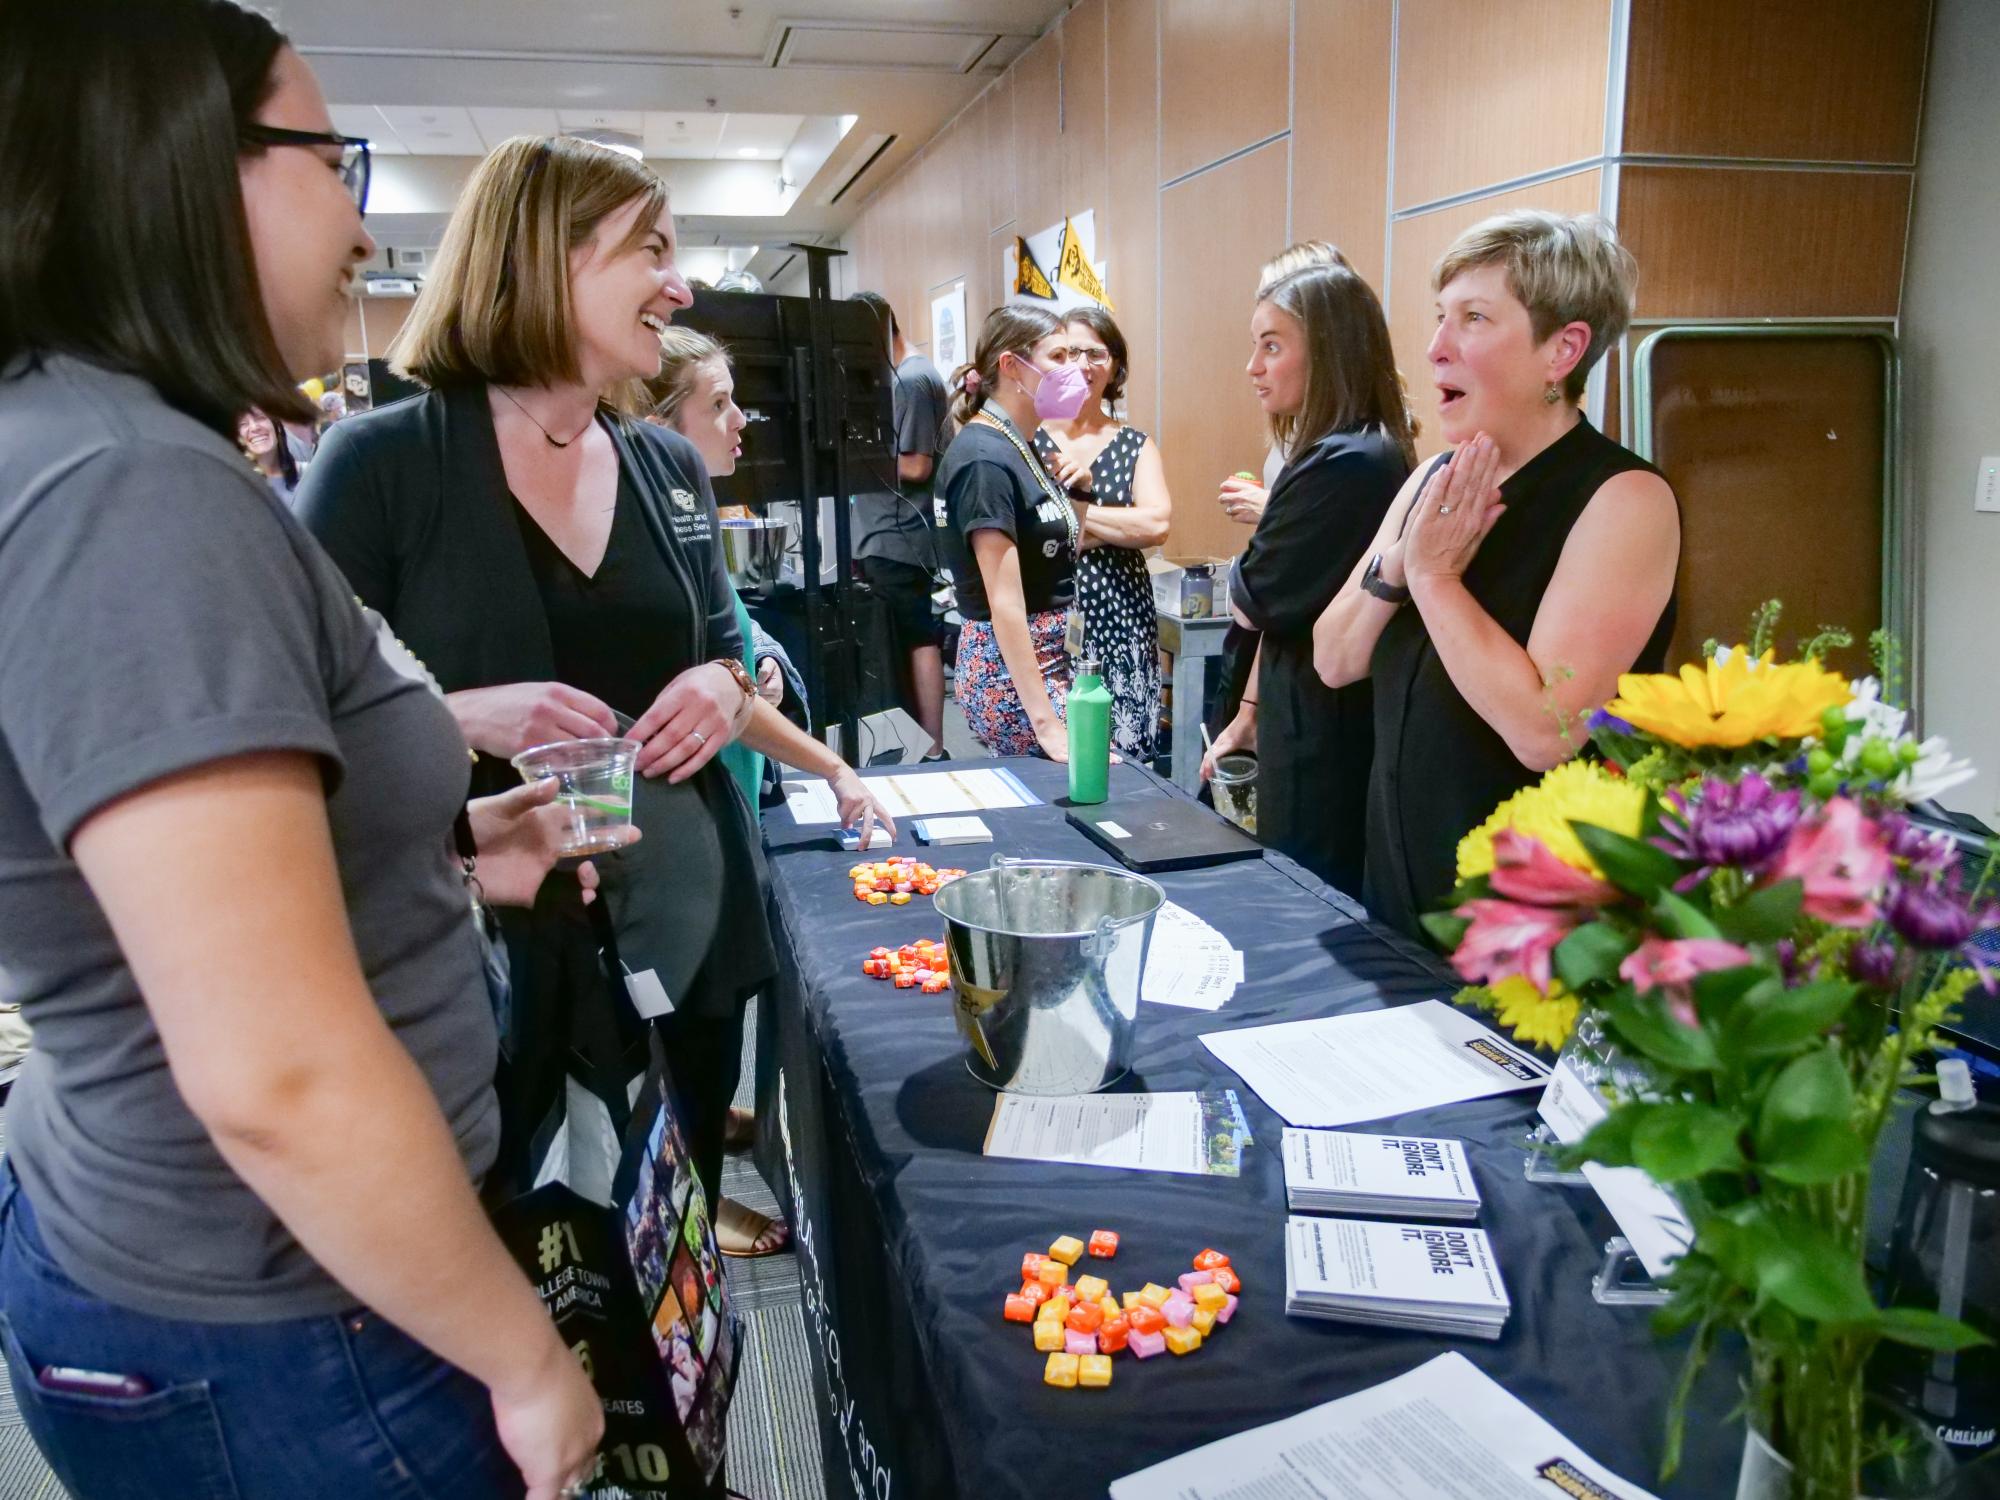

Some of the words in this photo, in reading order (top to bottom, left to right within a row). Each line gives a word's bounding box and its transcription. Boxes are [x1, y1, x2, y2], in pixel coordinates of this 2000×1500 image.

[693, 522, 711, 531] Serv
[694, 513, 708, 521] and
[1471, 1042, 1510, 1065] SURVEY
[1503, 1063, 1533, 1079] 2021
[1381, 1139, 1400, 1150] IT.
[1401, 1140, 1426, 1177] IGNORE
[1420, 1142, 1445, 1171] DON'T
[538, 1220, 583, 1274] #1
[1401, 1228, 1422, 1241] IT.
[1422, 1229, 1454, 1275] IGNORE
[1445, 1231, 1474, 1268] DON'T
[536, 1265, 575, 1299] LLEGE
[576, 1267, 610, 1289] TOWN
[604, 1399, 645, 1415] EATES
[612, 1443, 670, 1482] 10
[858, 1419, 891, 1500] and
